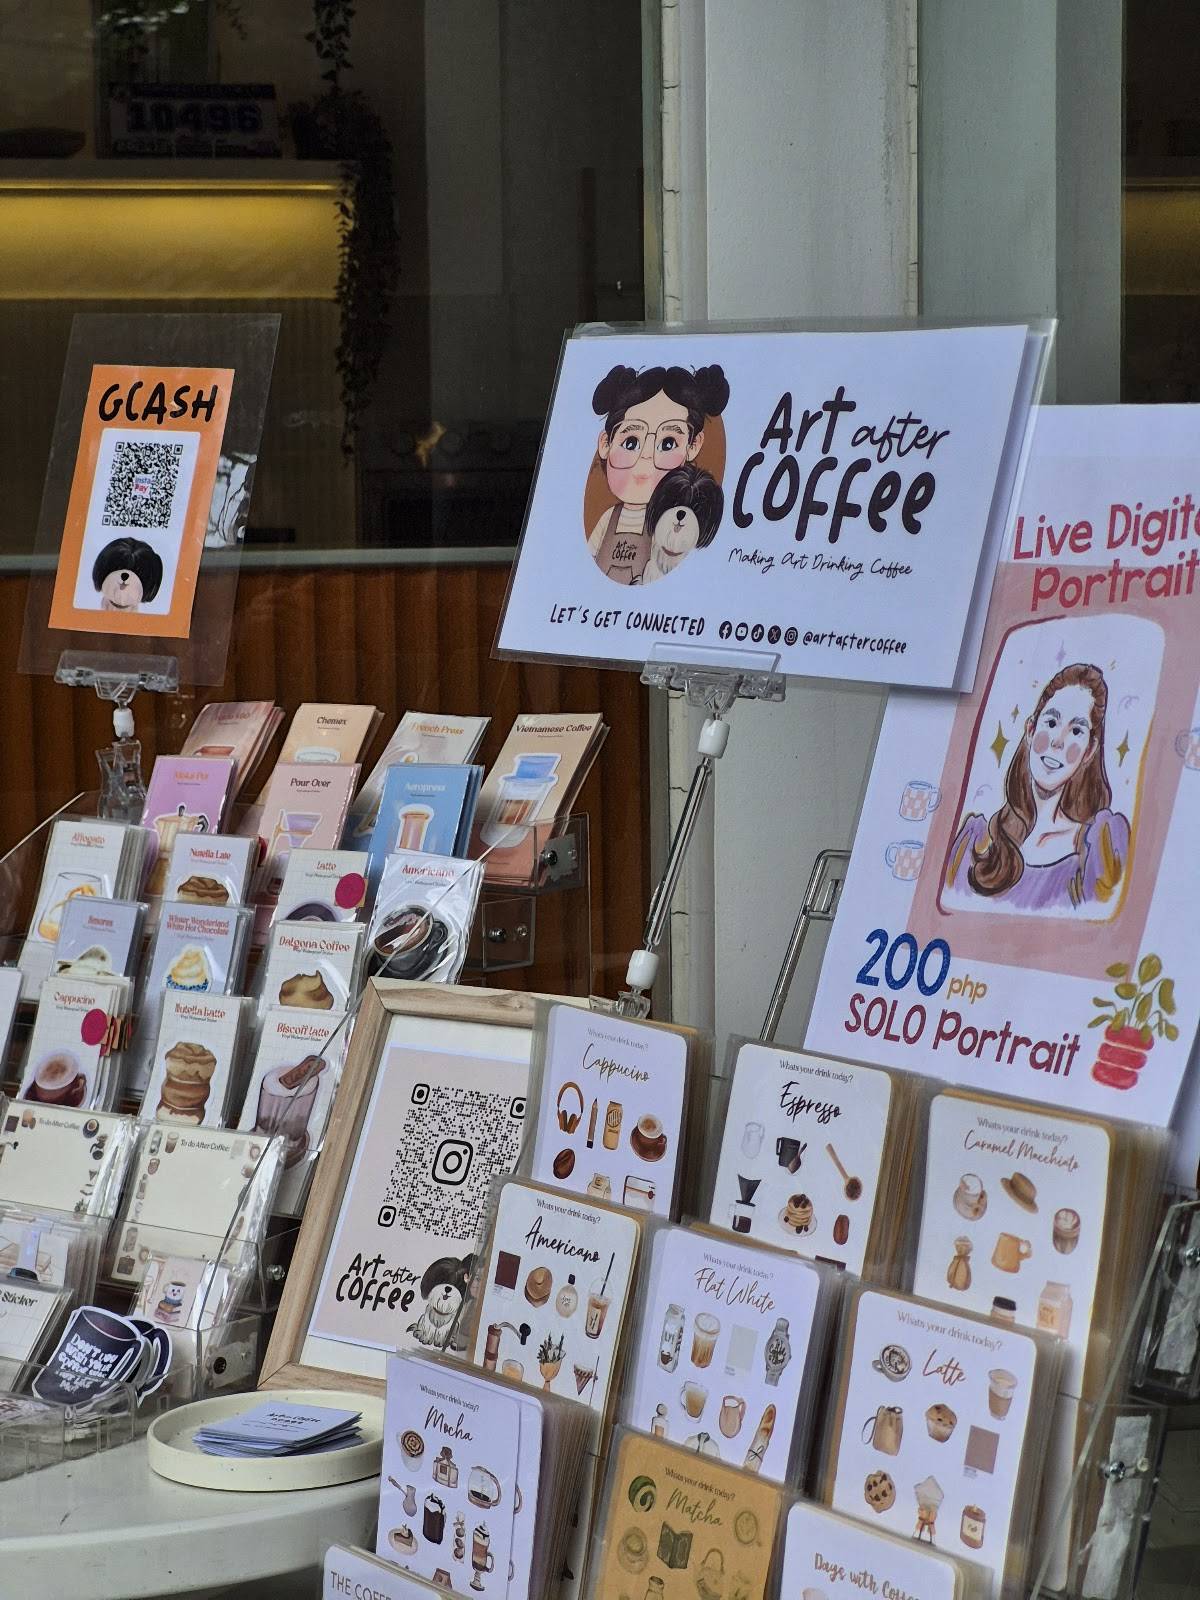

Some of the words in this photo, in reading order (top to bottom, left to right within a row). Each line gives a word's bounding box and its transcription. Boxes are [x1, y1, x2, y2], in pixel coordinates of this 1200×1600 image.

[98, 381, 218, 424] GCASH
[760, 386, 856, 455] Art
[850, 411, 950, 463] after
[1013, 514, 1093, 560] Live
[1106, 493, 1200, 557] Digit
[728, 547, 775, 574] Making
[781, 552, 809, 569] Art
[811, 553, 864, 581] Drinking
[870, 558, 912, 579] Coffee
[549, 603, 588, 624] LET'S
[593, 609, 621, 628] GET
[625, 611, 705, 636] CONNECTED
[515, 723, 565, 734] Vietnamese
[565, 723, 593, 733] Coffee
[290, 777, 310, 788] Pour
[311, 778, 332, 788] Over
[855, 928, 951, 997] 200
[946, 973, 988, 1005] php
[844, 992, 927, 1045] SOLO
[814, 1068, 831, 1078] drink
[780, 1080, 842, 1124] Espresso
[525, 1216, 600, 1262] Americano
[348, 1252, 386, 1278] Art
[382, 1266, 421, 1286] after
[1, 1290, 38, 1306] Sticker
[694, 1268, 726, 1300] Flat
[726, 1276, 775, 1314] White
[922, 1348, 966, 1386] Latte
[424, 1405, 473, 1441] Mocha
[666, 1488, 724, 1526] Matcha
[330, 1570, 352, 1596] THE
[850, 1569, 879, 1594] with
